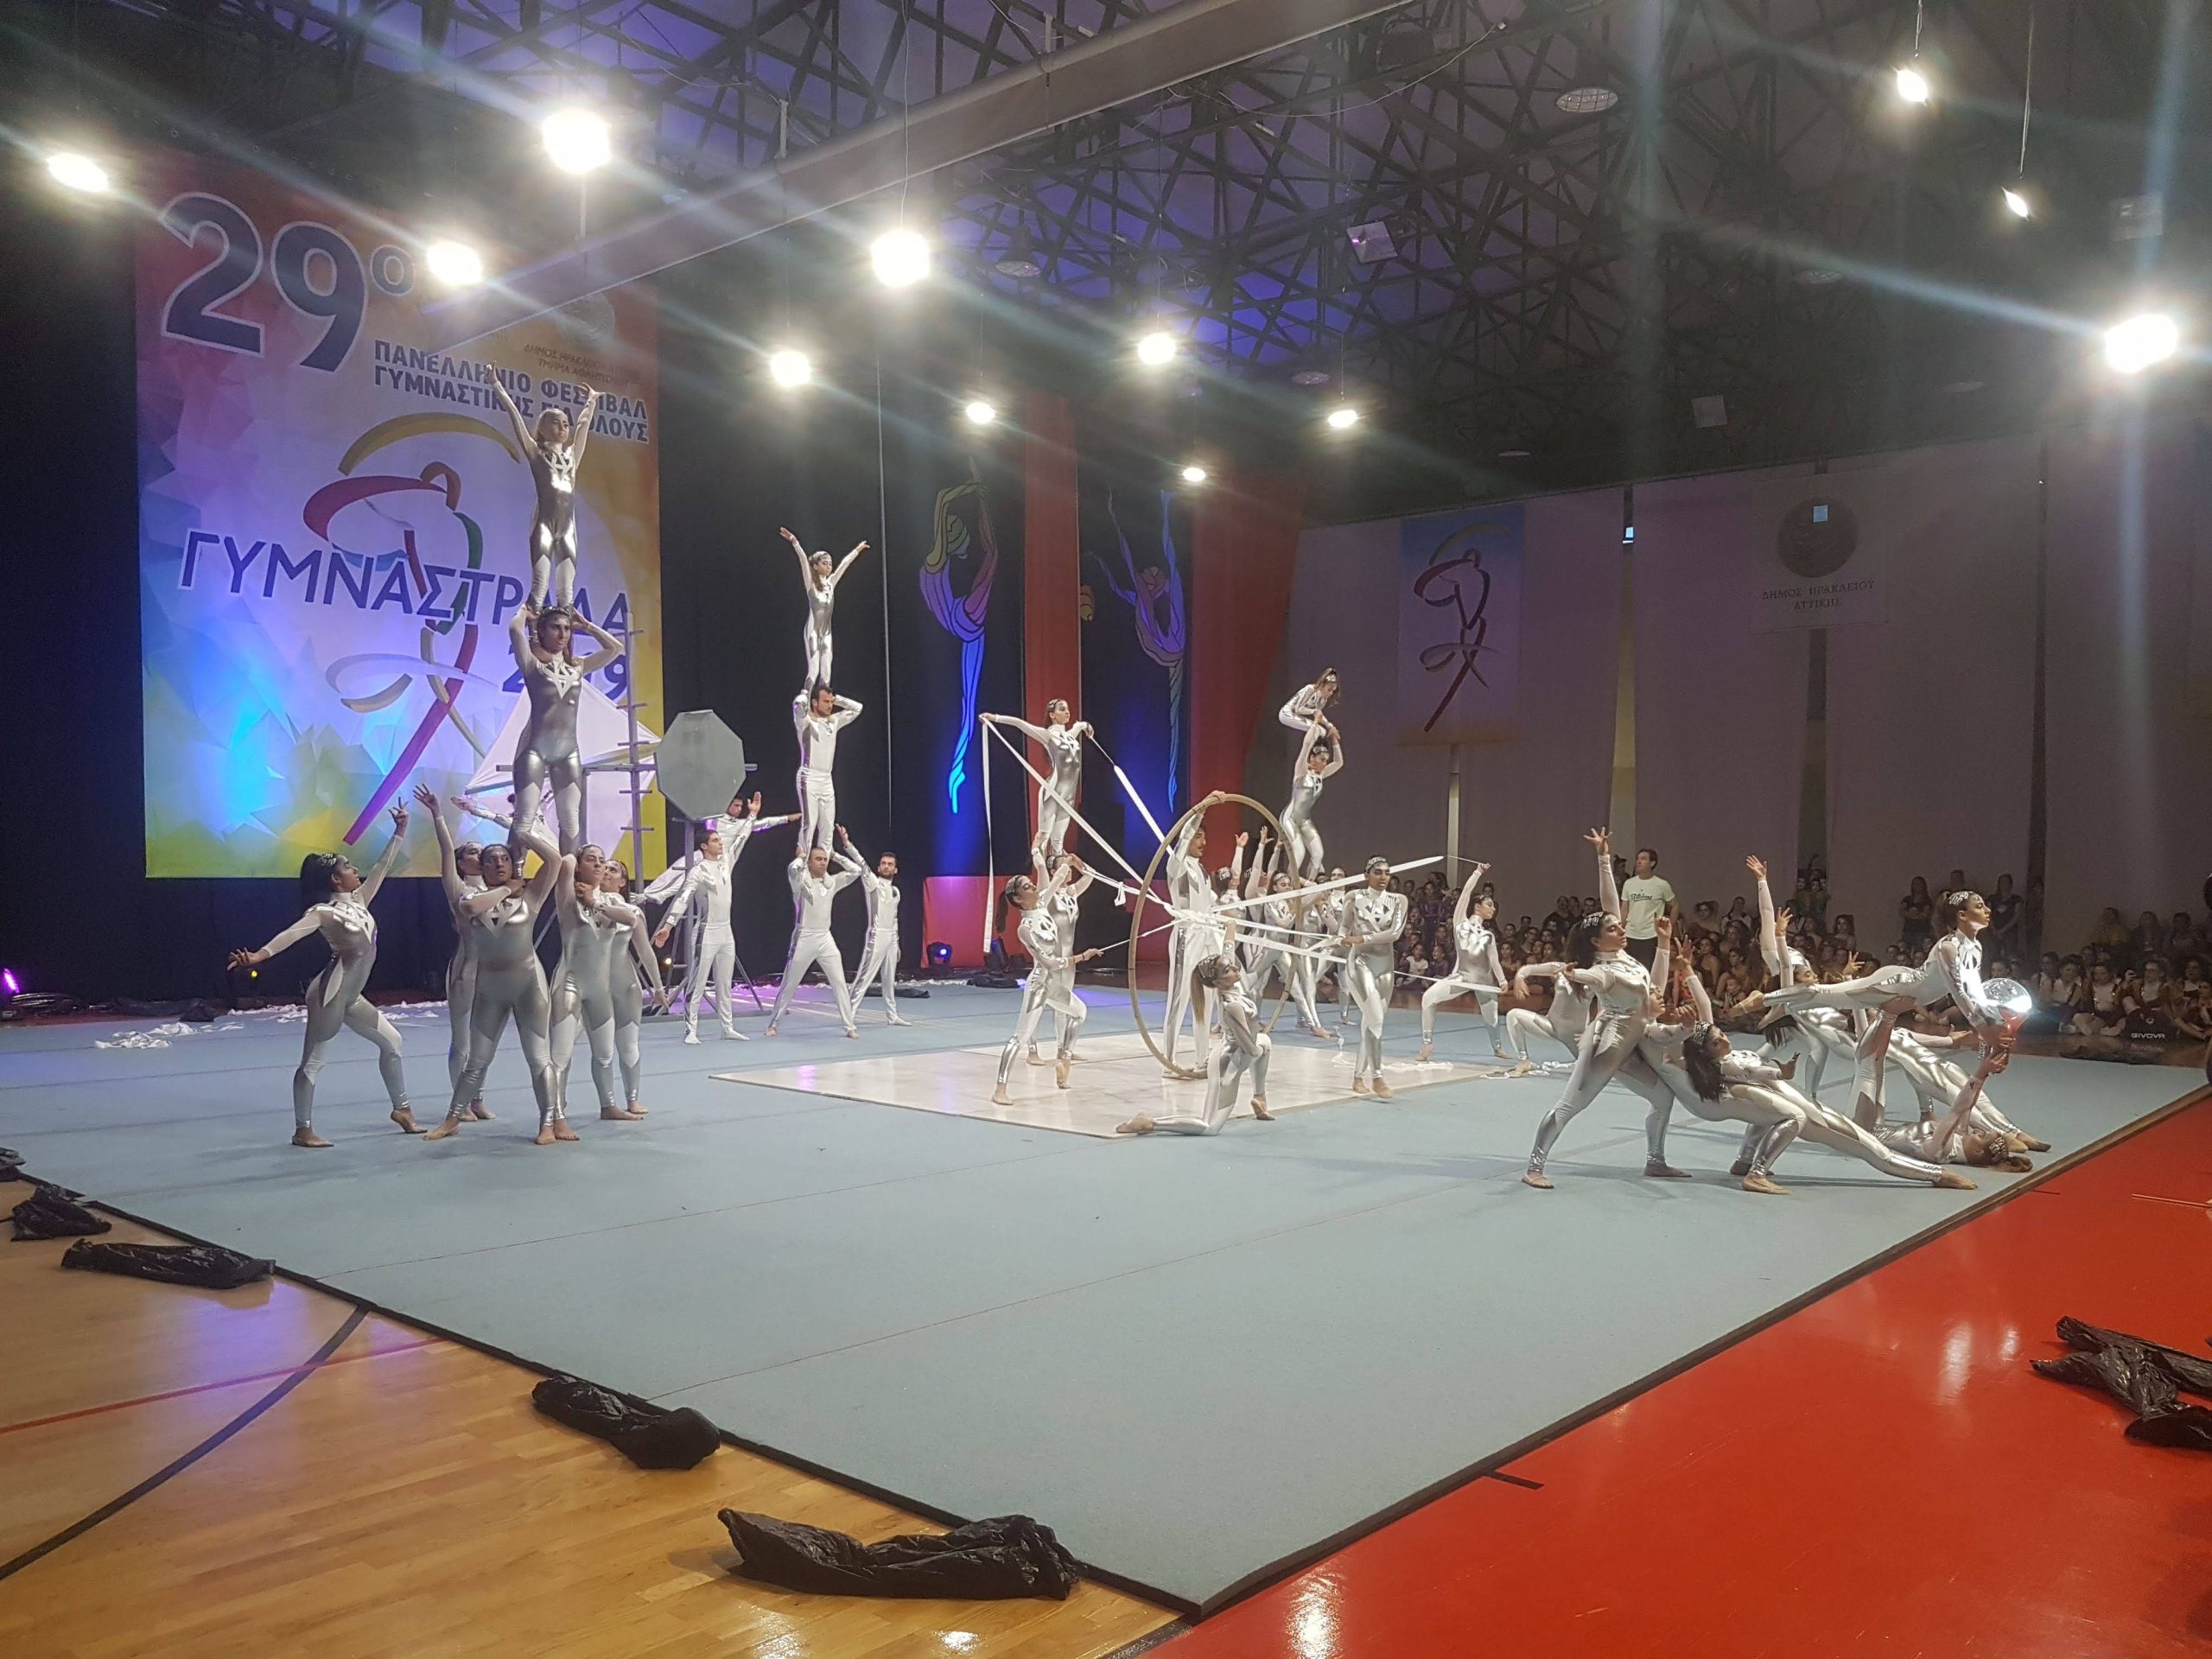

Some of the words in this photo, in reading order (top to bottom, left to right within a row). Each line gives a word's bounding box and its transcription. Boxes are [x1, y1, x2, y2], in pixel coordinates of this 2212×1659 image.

[373, 339, 532, 394] ΠΑΝΕΛΛΗΝΙΟ
[540, 378, 648, 421] ΦΕΣΙΒΑΛ
[180, 529, 629, 636] ΓΥΜΝΑΣΤΡΔΑ
[1762, 588, 1802, 601] ΔΗΜΟΣ
[1808, 580, 1875, 595] ΗΡΑΚΛΕΙΟΥ
[1794, 597, 1841, 610] ΑΤΤΙΚΗΣ
